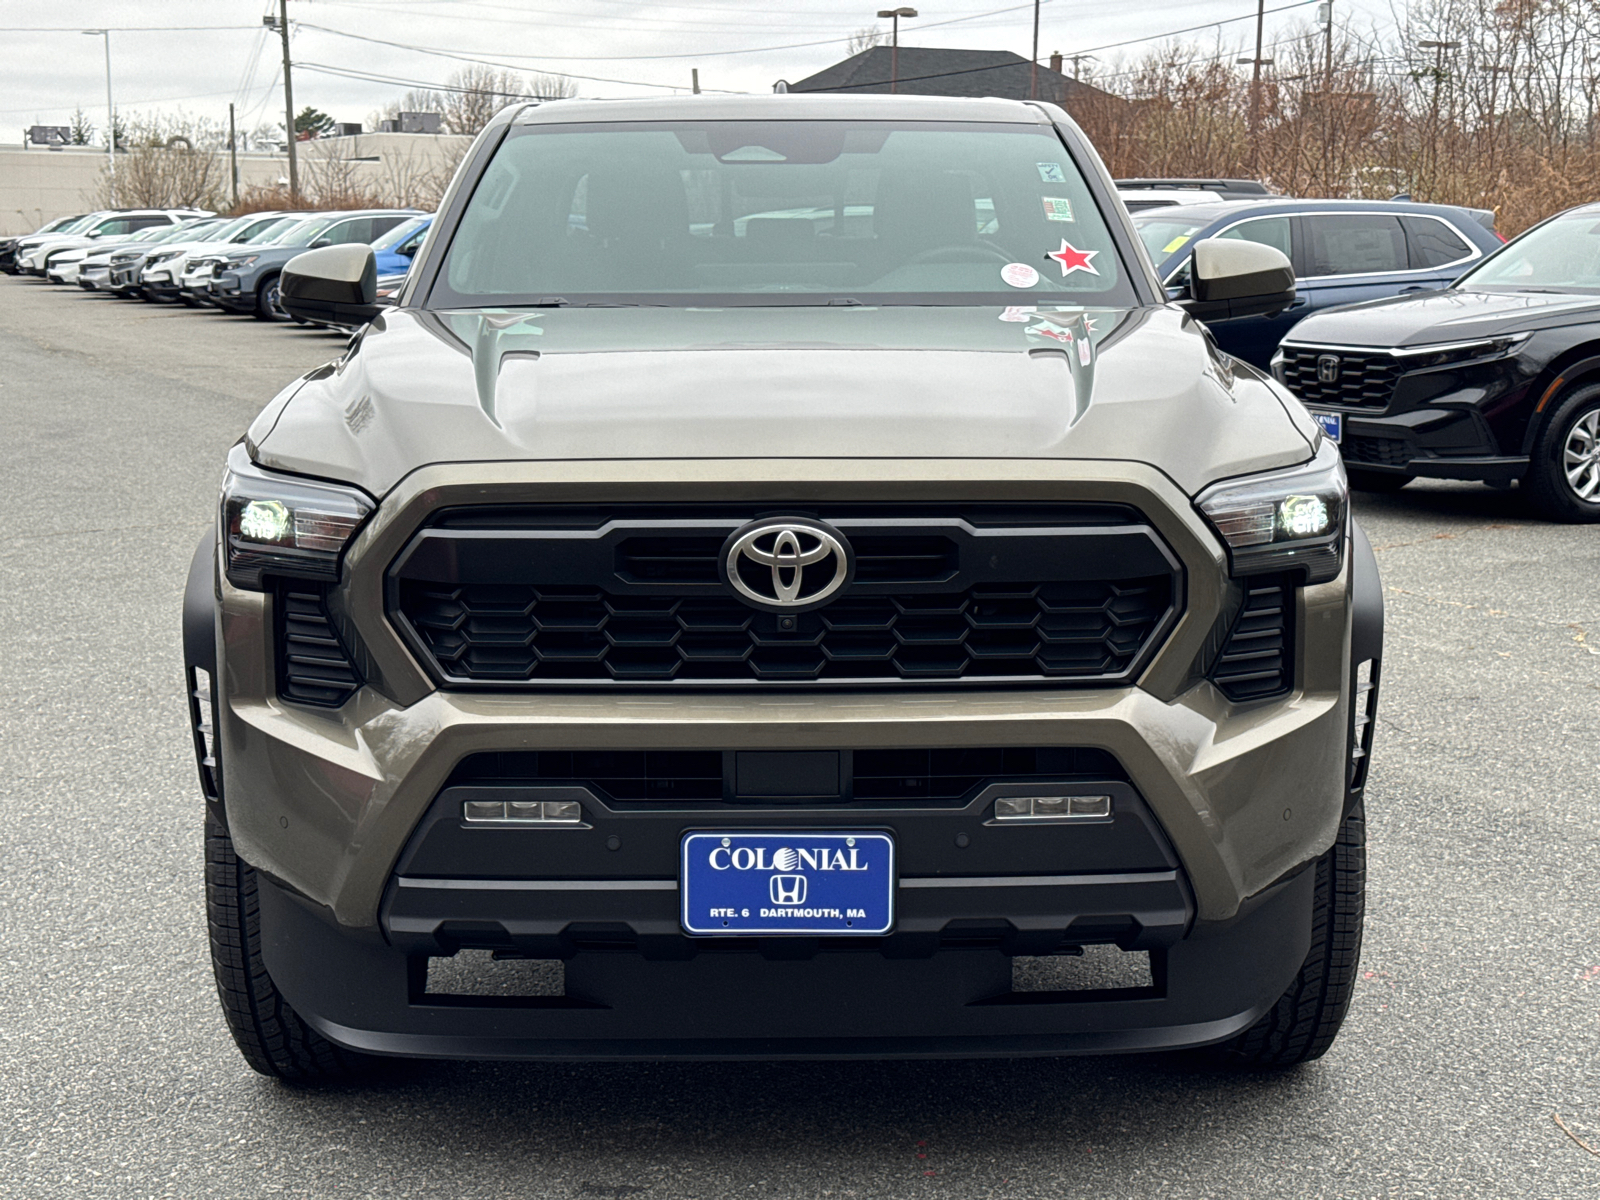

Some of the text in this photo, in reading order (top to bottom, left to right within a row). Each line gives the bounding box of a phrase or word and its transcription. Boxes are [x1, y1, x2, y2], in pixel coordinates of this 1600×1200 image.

[709, 847, 868, 871] COLONIAL
[710, 908, 866, 919] RTE. 6 DARTMOUTH, MA
